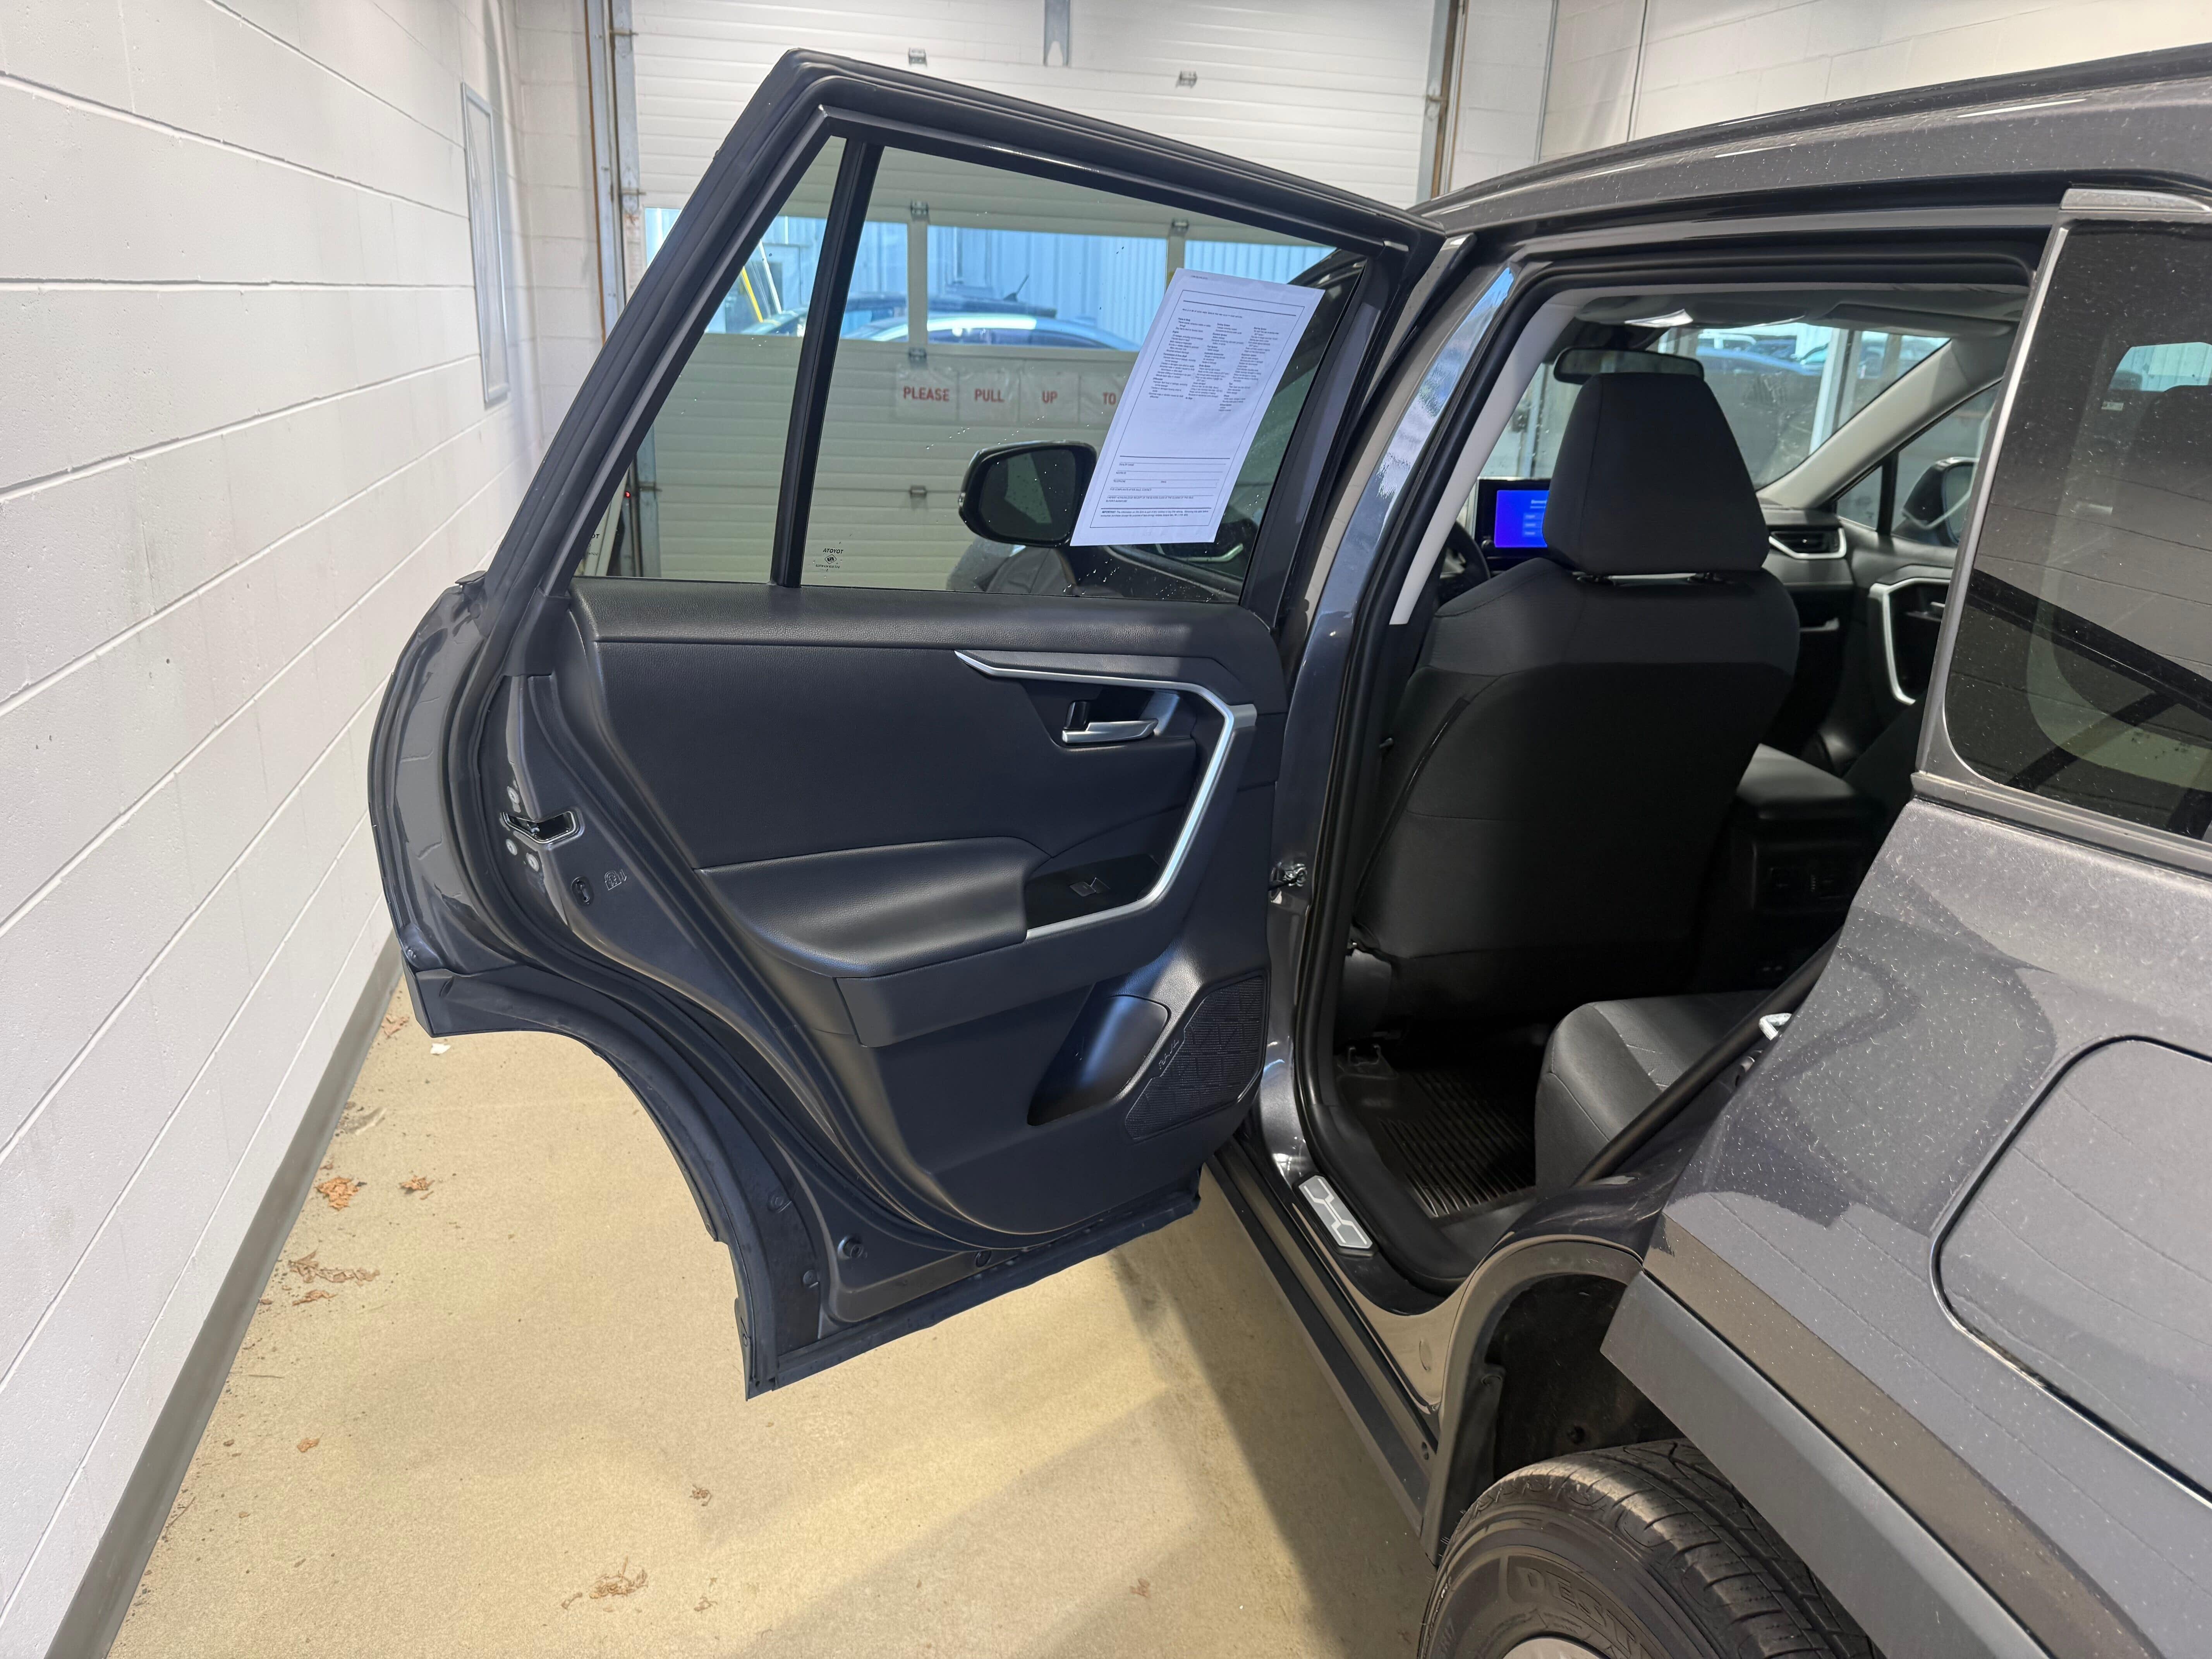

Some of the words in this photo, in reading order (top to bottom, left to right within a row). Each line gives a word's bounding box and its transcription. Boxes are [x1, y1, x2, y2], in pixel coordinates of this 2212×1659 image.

[903, 386, 950, 402] PLEASE
[974, 388, 1005, 402] PULL
[1042, 390, 1058, 404] UP
[1103, 392, 1117, 405] TO
